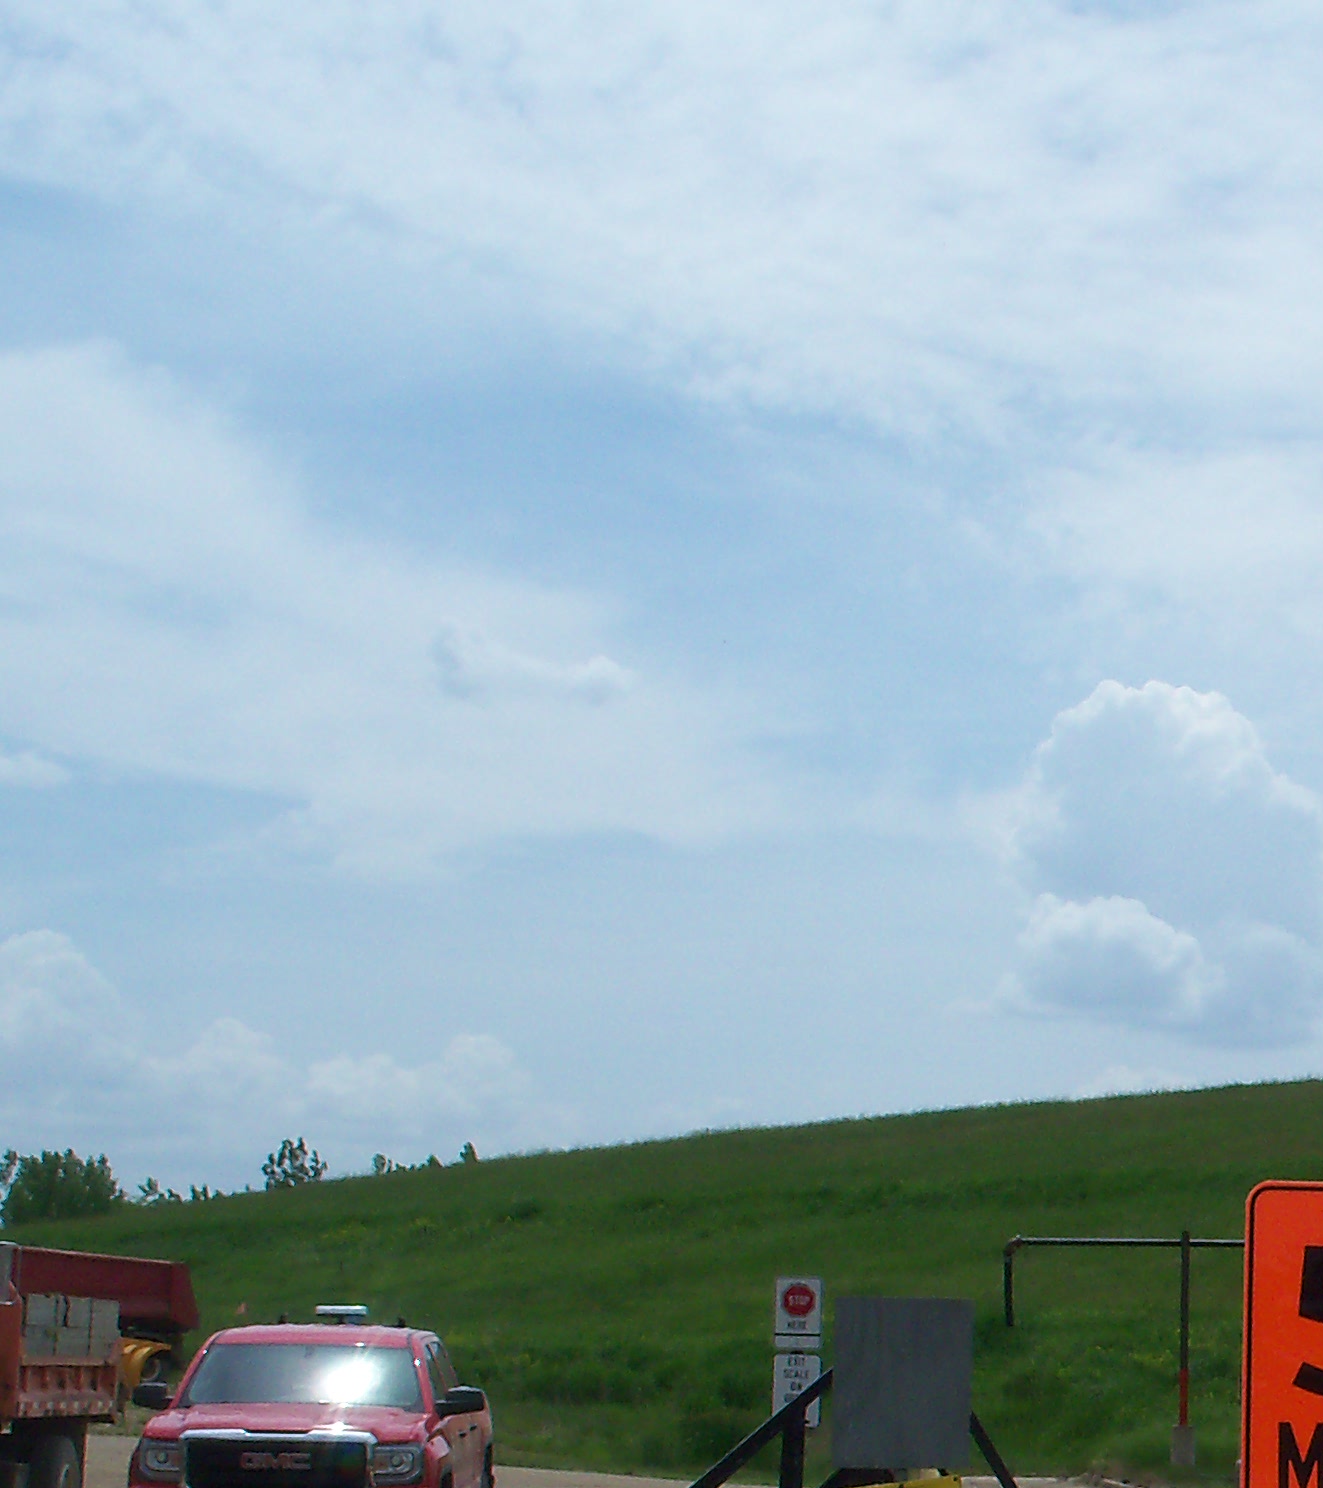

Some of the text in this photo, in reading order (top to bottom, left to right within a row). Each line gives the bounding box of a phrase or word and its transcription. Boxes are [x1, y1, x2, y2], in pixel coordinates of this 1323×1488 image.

[789, 1294, 811, 1306] STOP
[783, 1368, 810, 1379] SCALE
[241, 1452, 311, 1470] GMC
